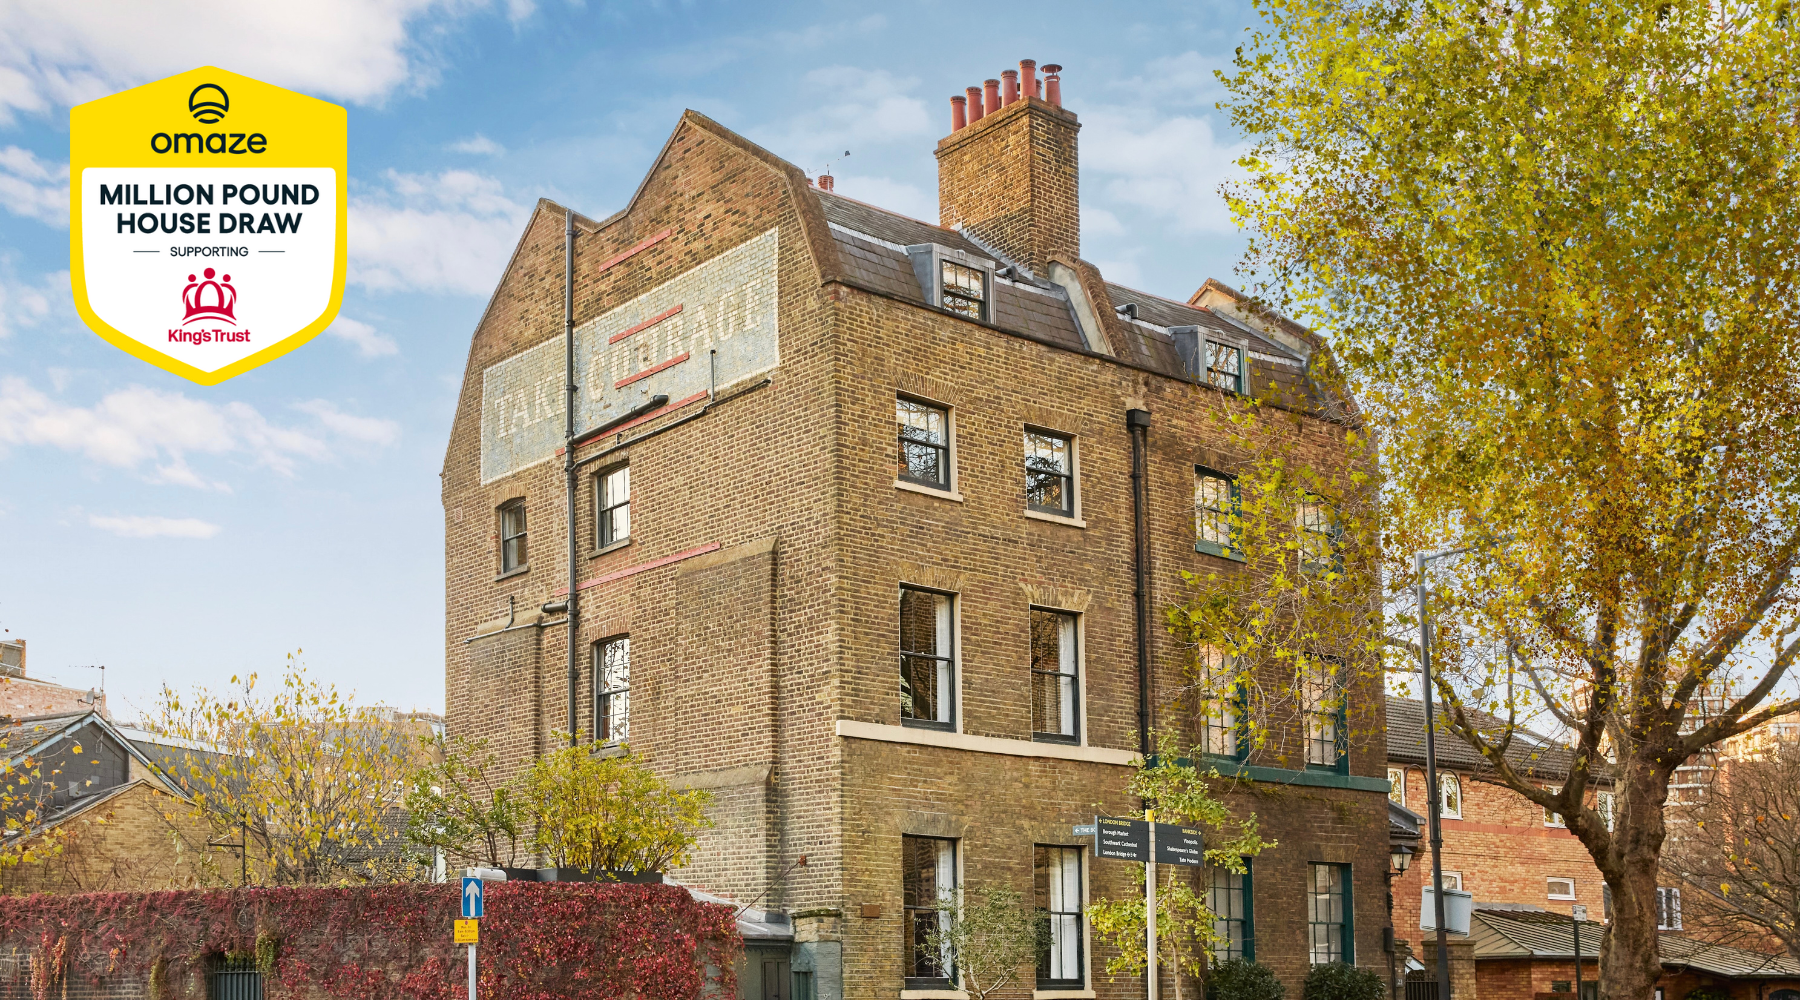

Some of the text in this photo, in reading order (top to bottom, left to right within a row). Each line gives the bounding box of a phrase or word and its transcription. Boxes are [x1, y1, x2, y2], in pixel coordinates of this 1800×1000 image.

[1102, 828, 1117, 836] Borough
[1102, 838, 1121, 846] Southwark
[1116, 850, 1126, 858] Bridge
